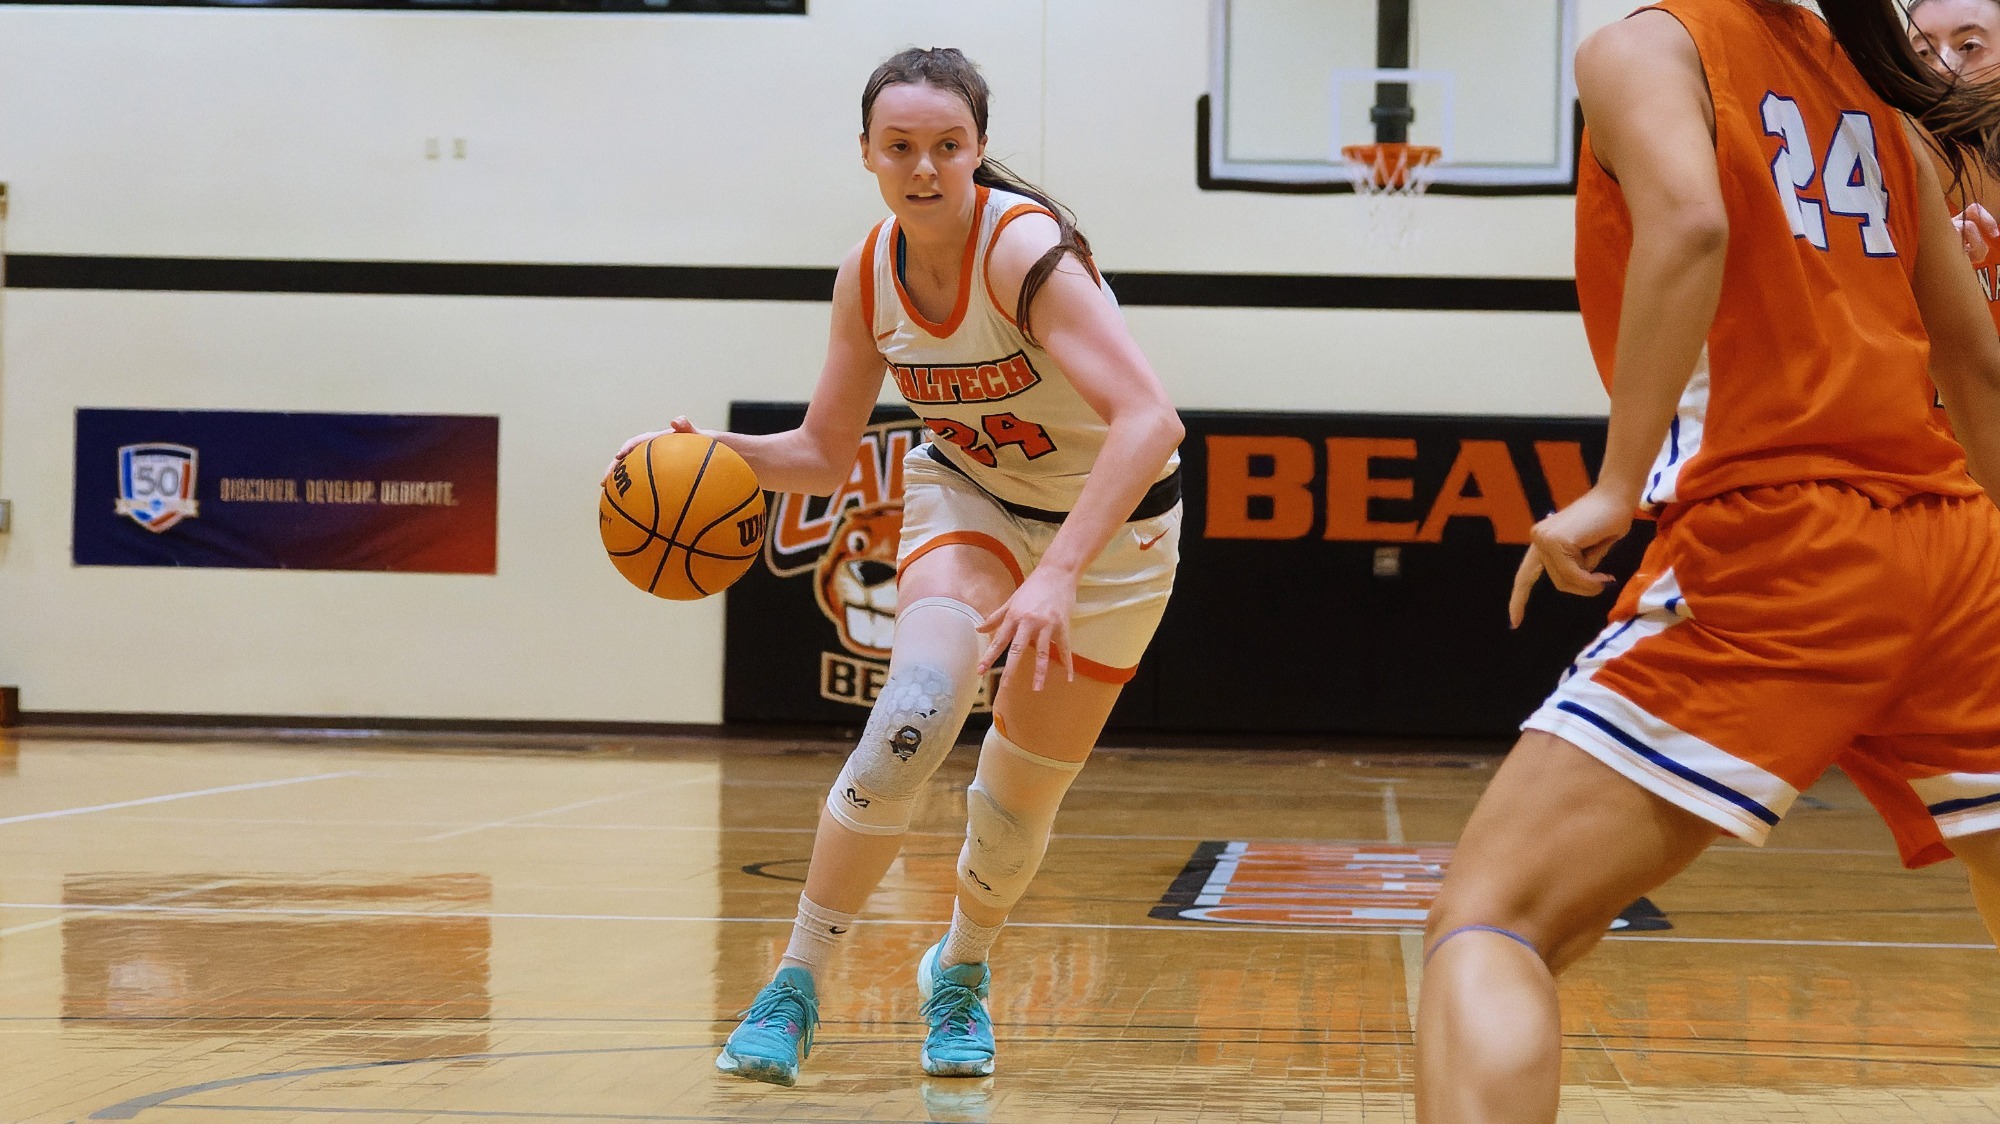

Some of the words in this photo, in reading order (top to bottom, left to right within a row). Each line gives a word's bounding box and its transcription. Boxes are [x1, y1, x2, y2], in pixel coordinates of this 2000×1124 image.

[1759, 89, 1898, 258] 24
[923, 412, 1058, 468] 24
[137, 466, 179, 497] 50
